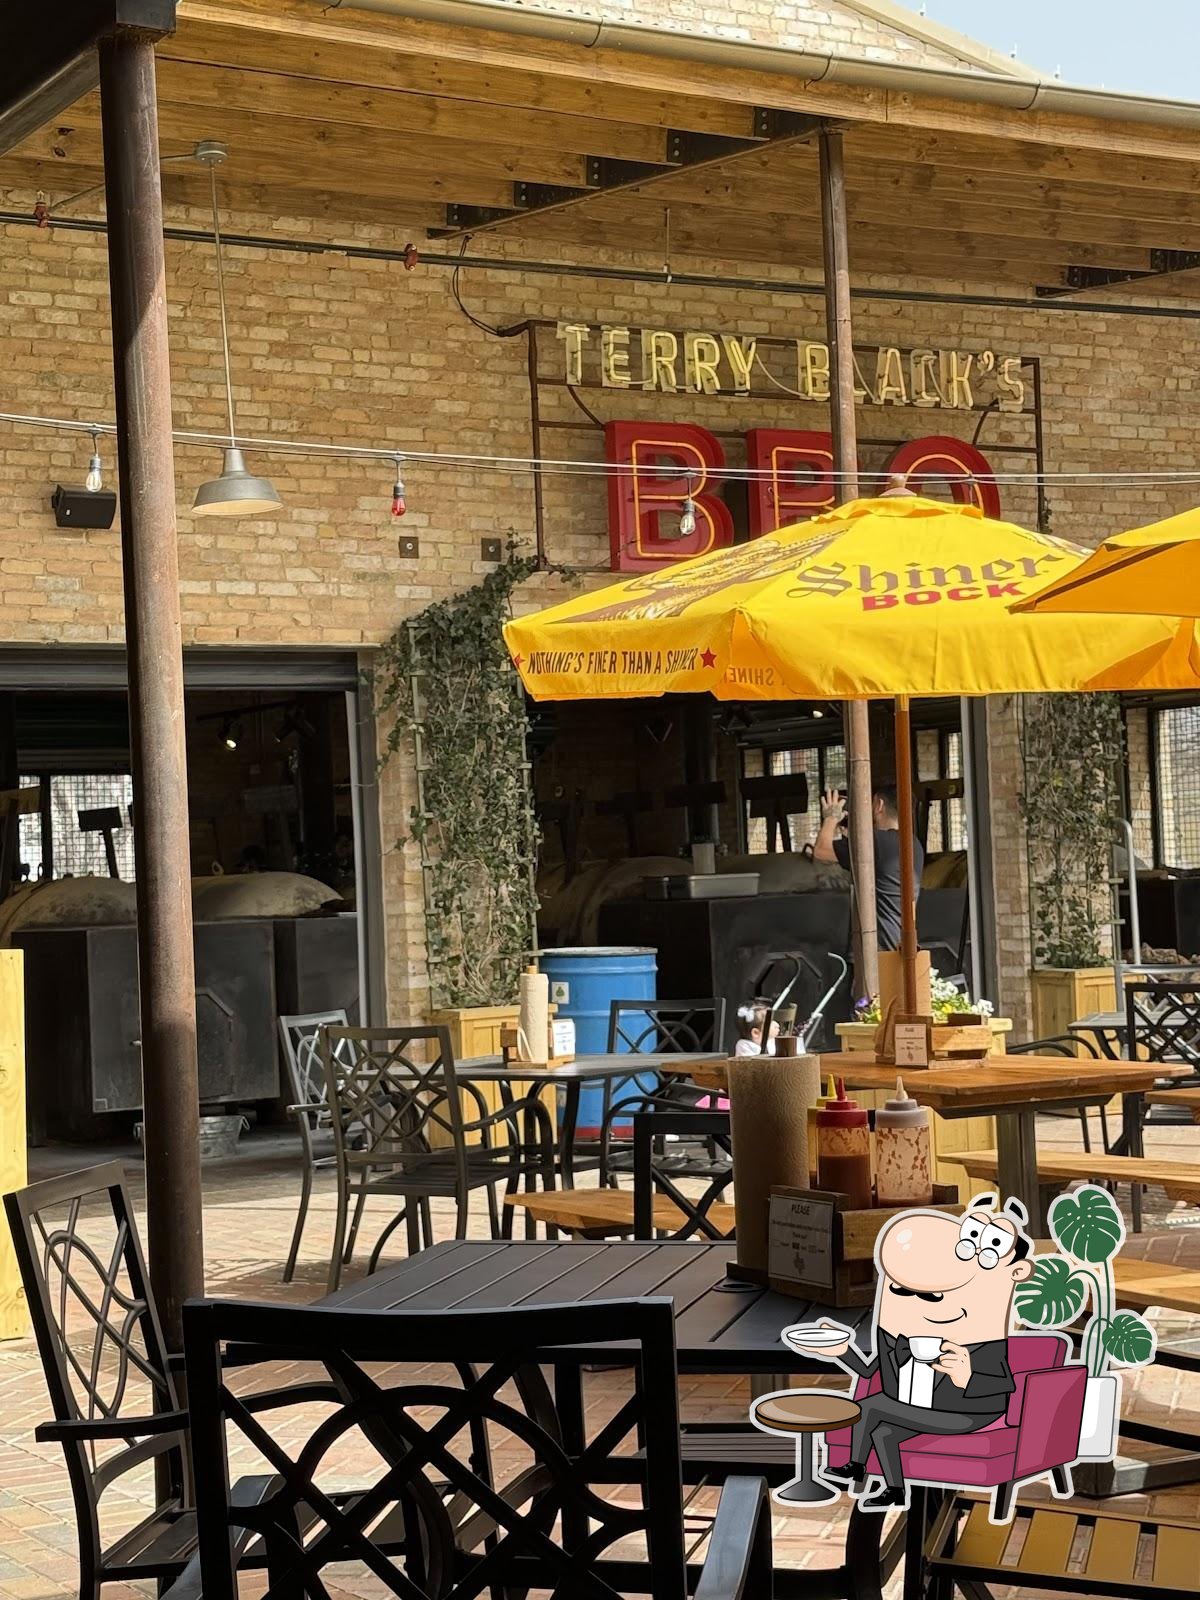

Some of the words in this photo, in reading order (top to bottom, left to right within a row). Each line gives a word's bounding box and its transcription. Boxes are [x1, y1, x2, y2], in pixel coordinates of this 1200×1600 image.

[557, 322, 757, 397] TERRY
[797, 339, 1022, 413] BACK'S
[786, 554, 1065, 598] Shiner
[861, 582, 1027, 611] BOCK
[527, 652, 585, 675] NOTHING'S
[586, 651, 617, 674] FINER
[622, 651, 652, 674] THAN
[653, 651, 662, 674] A
[665, 648, 698, 675] SHINER
